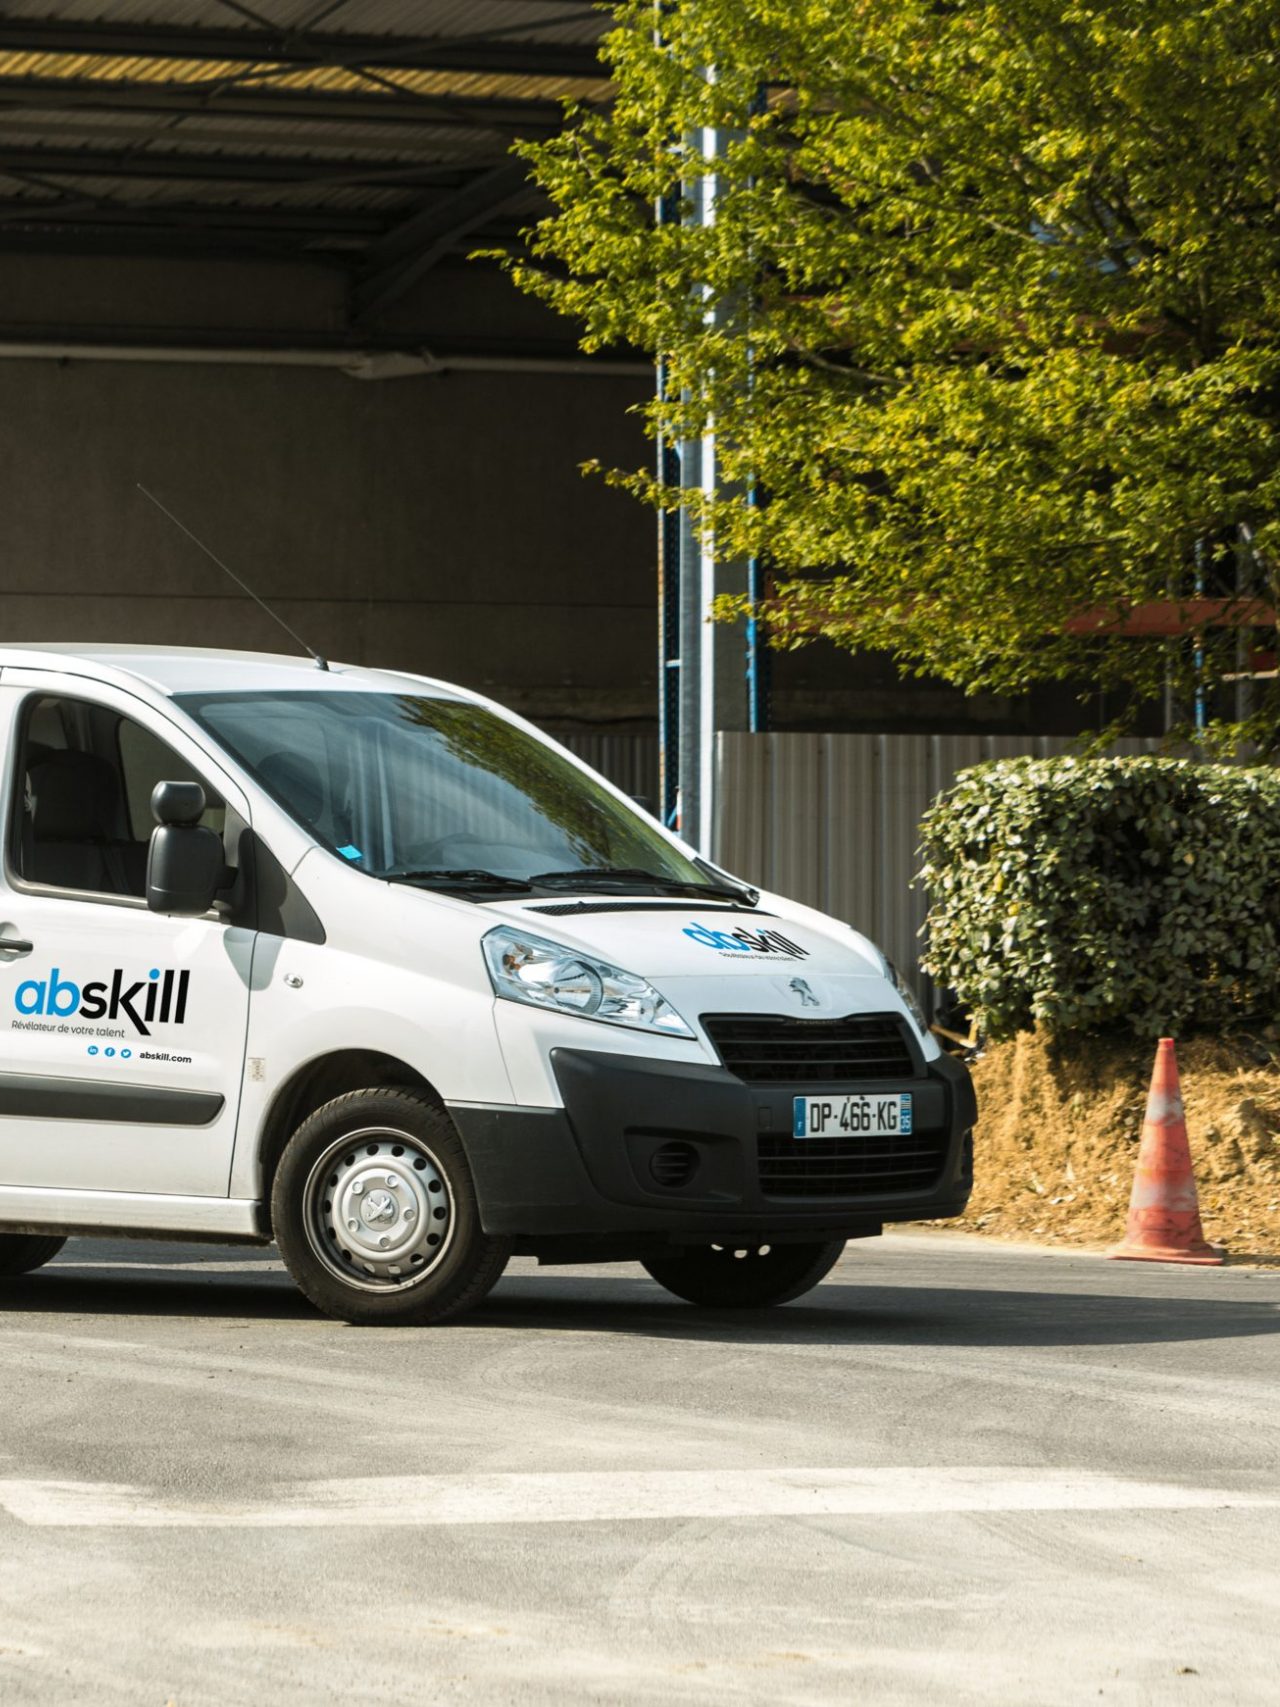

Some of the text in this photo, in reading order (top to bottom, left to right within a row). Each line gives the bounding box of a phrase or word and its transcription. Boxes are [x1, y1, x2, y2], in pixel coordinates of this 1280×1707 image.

[682, 921, 811, 960] abskill
[14, 967, 190, 1036] abskill
[11, 1020, 125, 1039] Révélateur de votre talent
[139, 1051, 192, 1064] abskill.com
[810, 1101, 897, 1133] DP-466-KG
